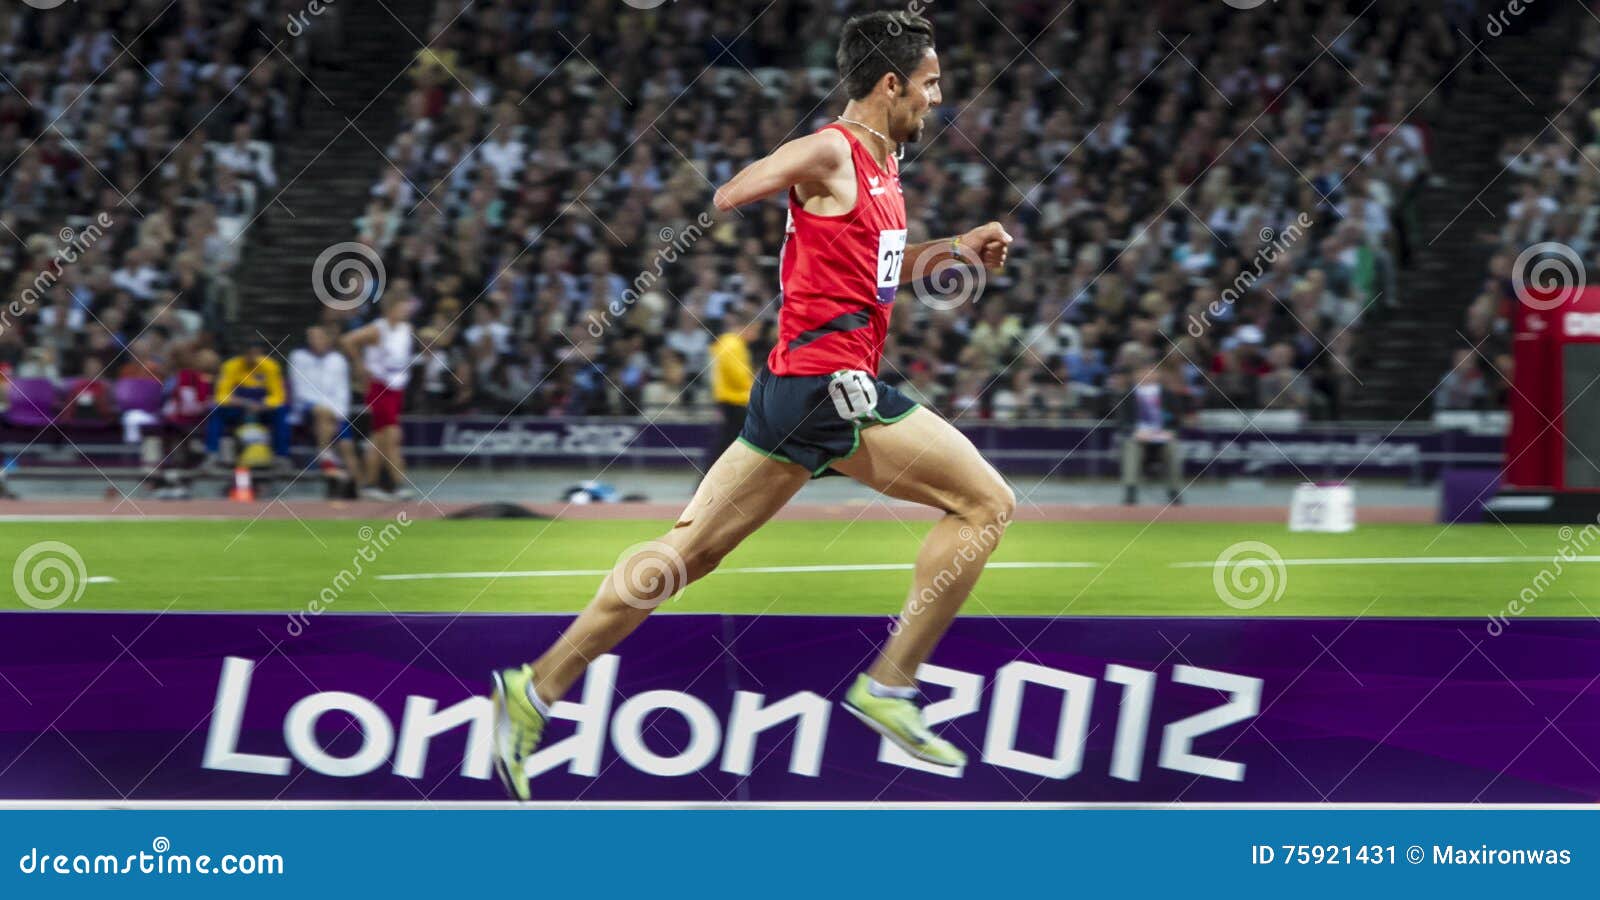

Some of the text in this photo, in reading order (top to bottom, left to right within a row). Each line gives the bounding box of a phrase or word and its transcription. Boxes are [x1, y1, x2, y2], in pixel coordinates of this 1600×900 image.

[883, 250, 904, 282] 27
[835, 374, 871, 413] 11
[203, 654, 1264, 782] London 2012
